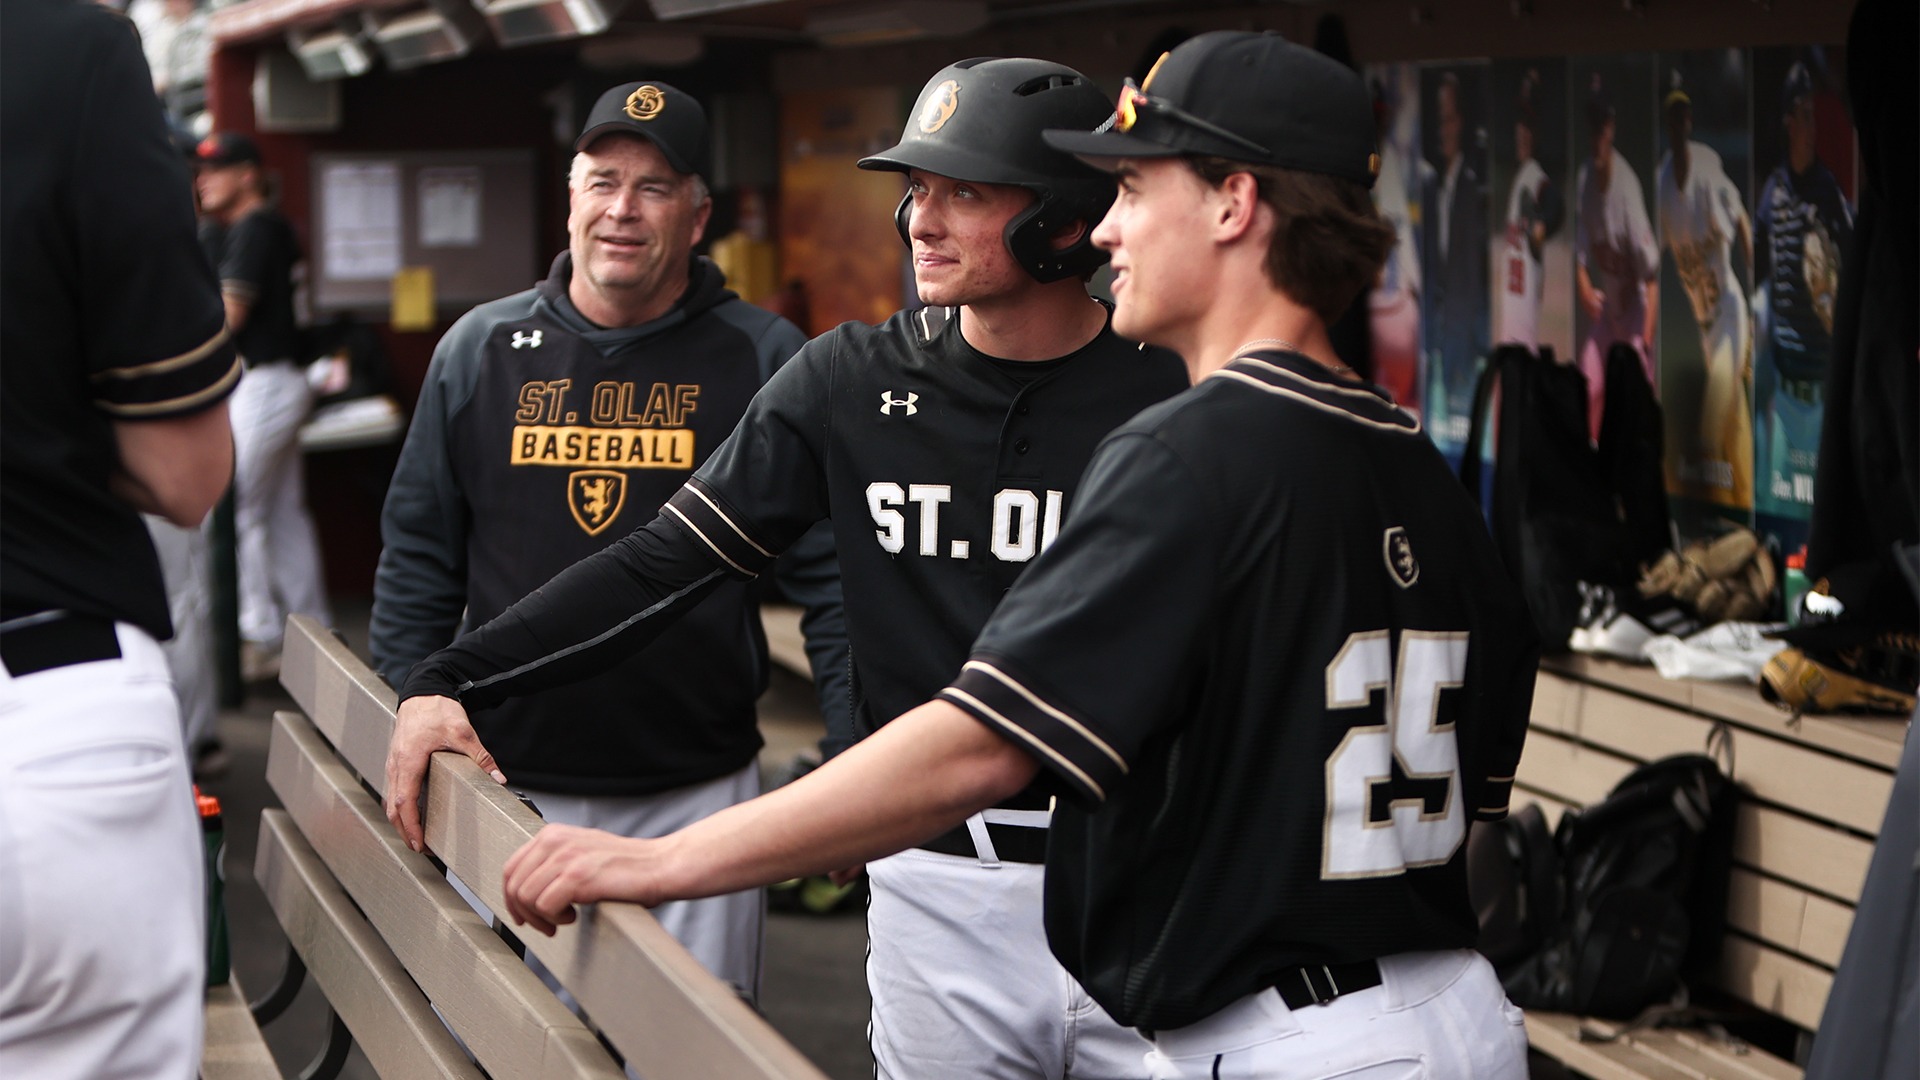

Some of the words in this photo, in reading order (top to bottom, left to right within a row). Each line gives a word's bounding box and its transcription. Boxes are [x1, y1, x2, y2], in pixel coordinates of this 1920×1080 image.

[515, 378, 578, 424] ST.
[590, 381, 700, 427] OLAF
[520, 431, 684, 464] BASEBALL
[865, 481, 970, 560] ST.
[1320, 628, 1470, 880] 25
